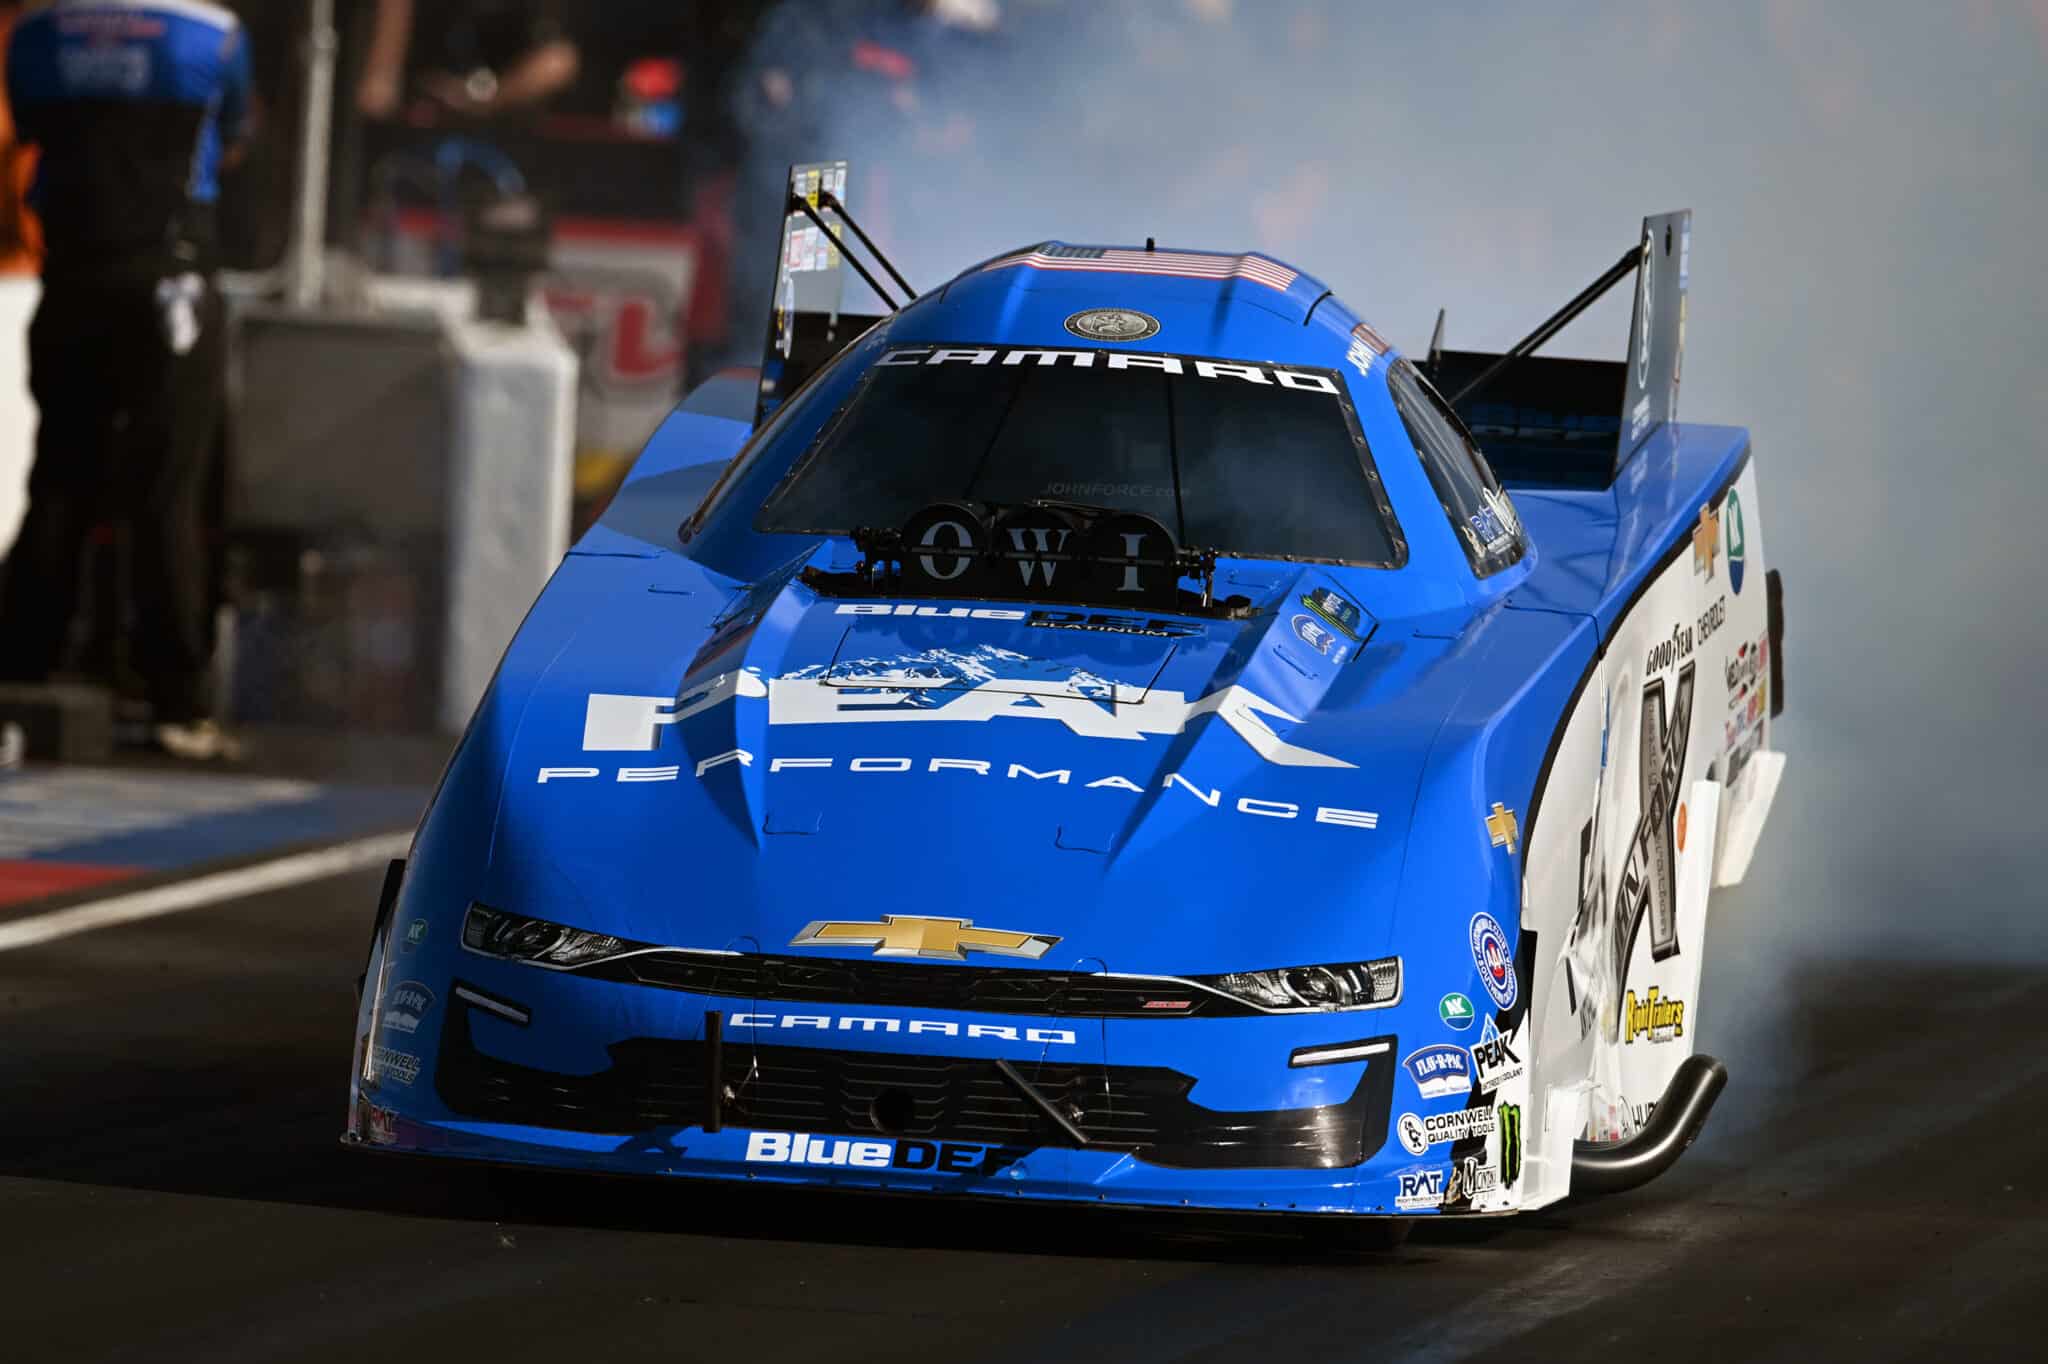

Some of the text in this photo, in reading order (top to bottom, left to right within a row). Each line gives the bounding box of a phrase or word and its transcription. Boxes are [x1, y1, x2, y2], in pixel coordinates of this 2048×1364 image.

[874, 349, 1340, 394] CAMARO
[1031, 622, 1169, 637] PLATINUM
[1646, 623, 1693, 677] GOODYEAR
[582, 665, 1358, 769] PEAK
[537, 748, 1380, 830] PERFORMANCE
[729, 1013, 1077, 1044] CAMARO
[1473, 1036, 1521, 1079] PEAK
[1425, 1106, 1494, 1131] CORNWELL
[1427, 1123, 1495, 1143] QUALITY TOOLS
